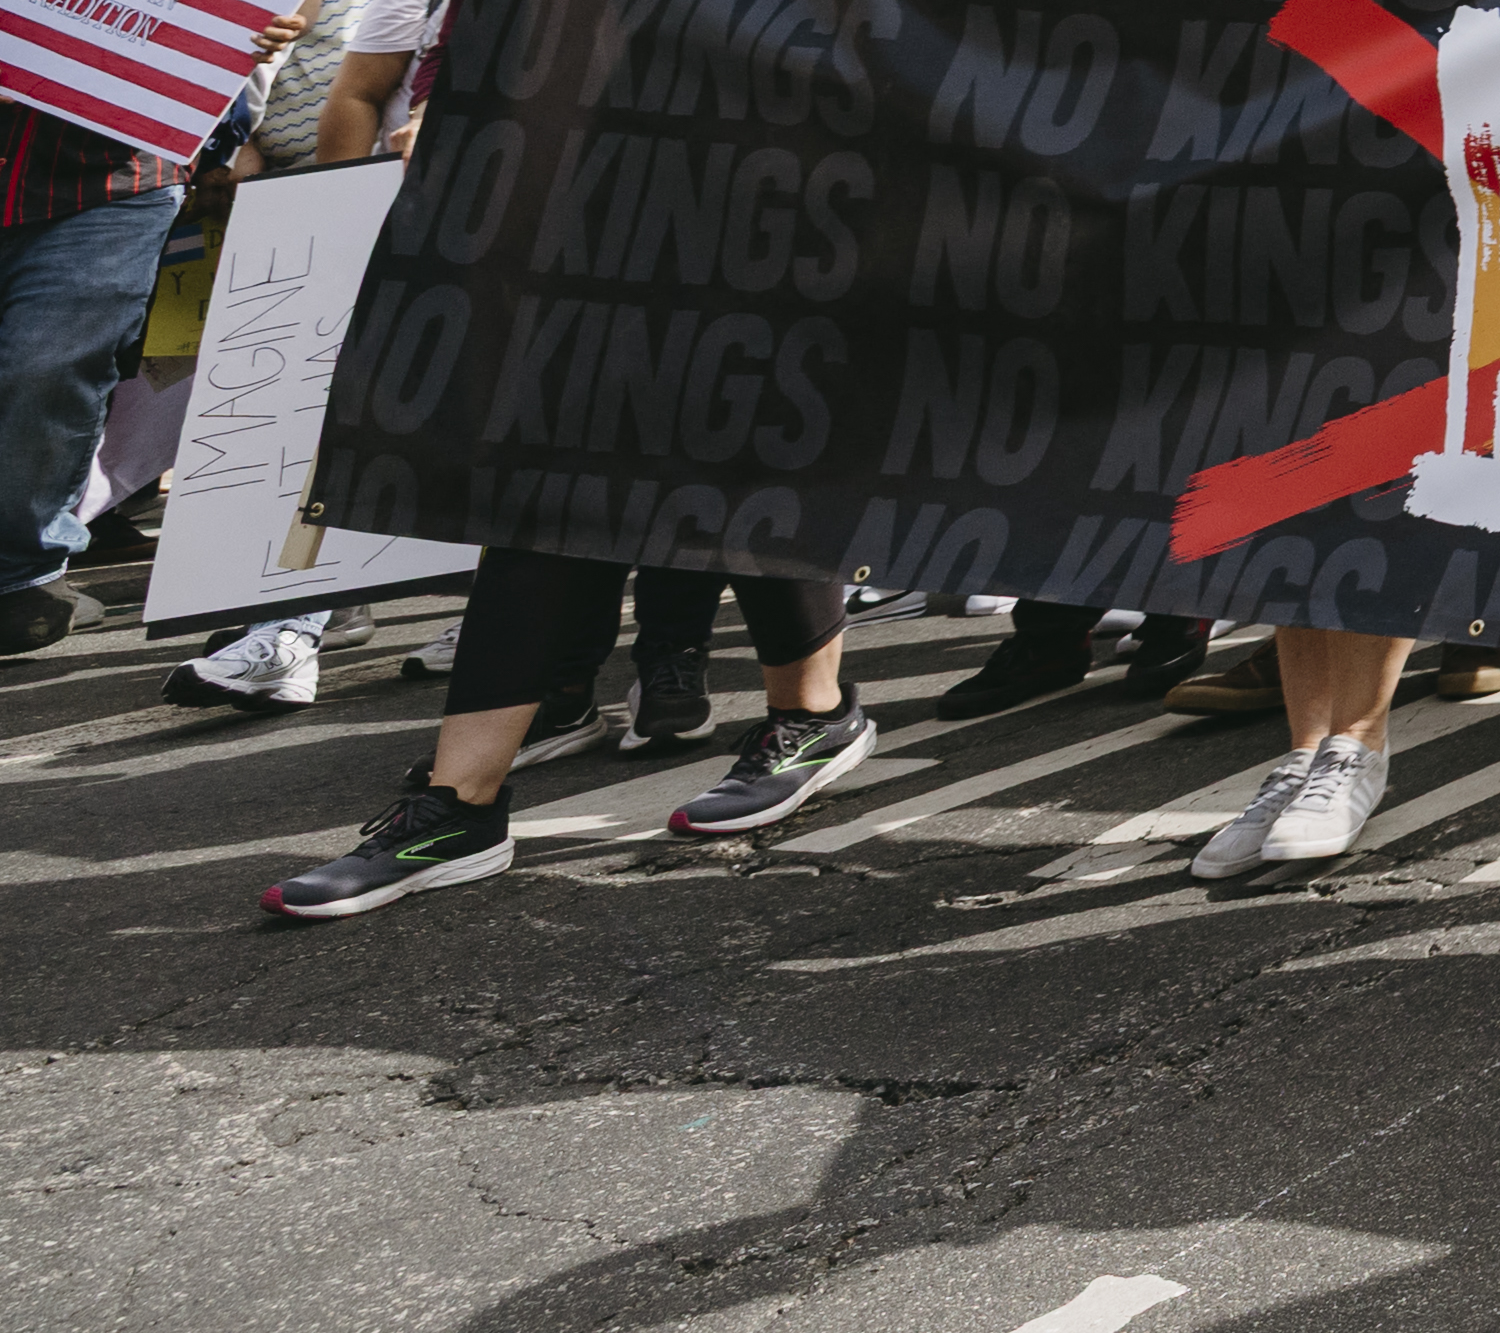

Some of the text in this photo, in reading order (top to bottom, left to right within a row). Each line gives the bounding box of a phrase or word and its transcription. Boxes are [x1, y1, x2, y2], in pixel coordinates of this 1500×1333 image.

[927, 3, 1119, 157] NO
[529, 129, 875, 303] KINGS
[908, 162, 1071, 319] NO
[180, 235, 315, 497] IMAGINE
[481, 294, 850, 472] KINGS
[879, 326, 1060, 487] NO
